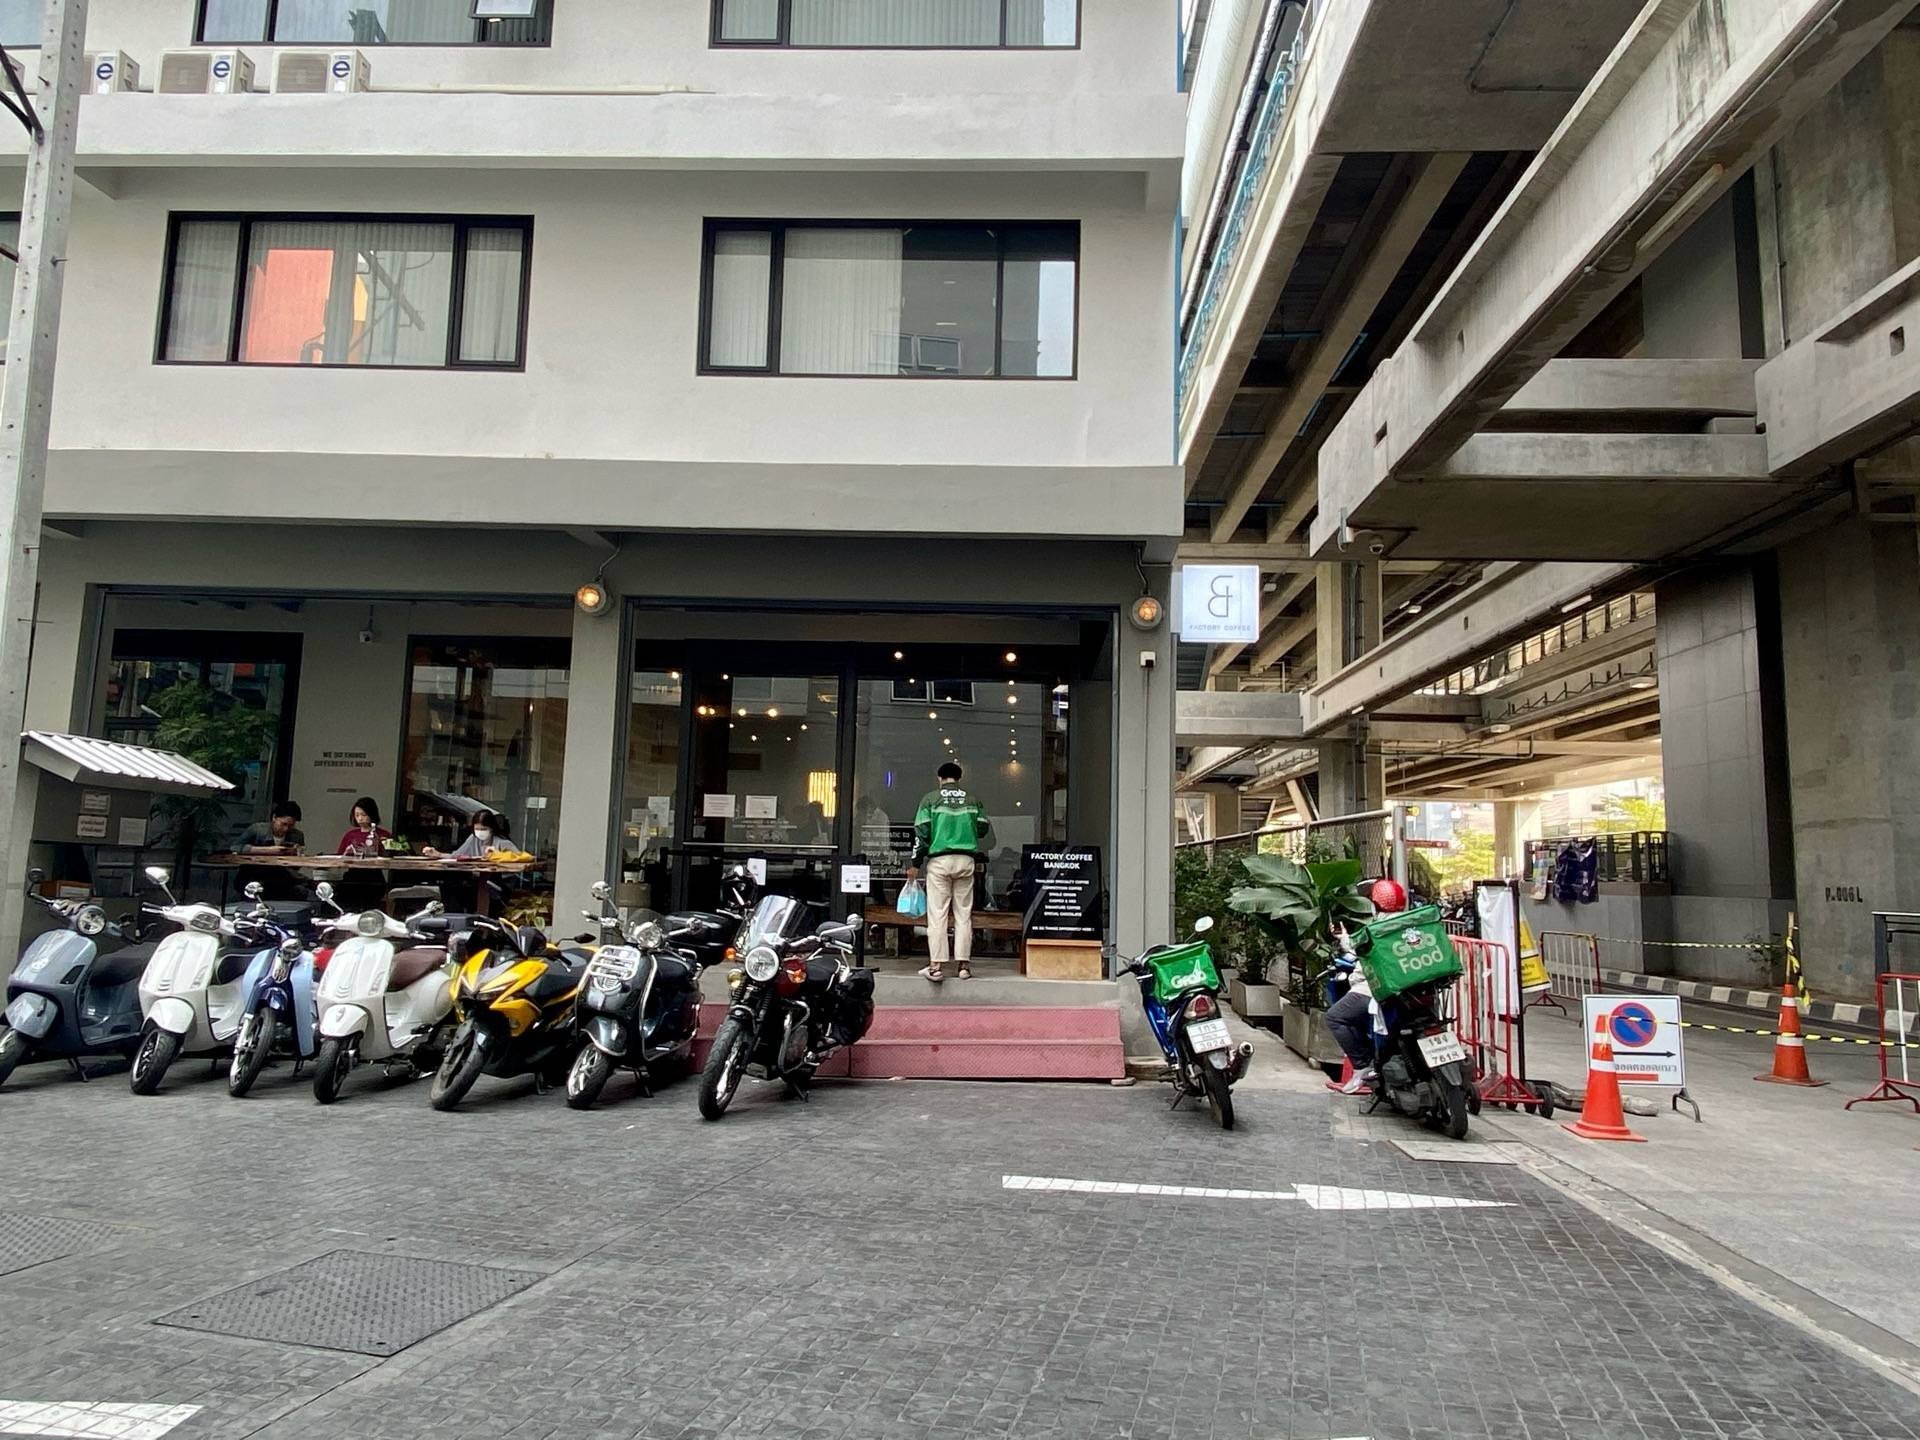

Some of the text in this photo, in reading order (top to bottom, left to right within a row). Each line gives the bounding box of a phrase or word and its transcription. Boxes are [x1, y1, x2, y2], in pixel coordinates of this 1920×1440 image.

[940, 789, 967, 797] Grab
[1065, 853, 1093, 861] COFFEE
[1044, 861, 1080, 869] BANGKOK
[1398, 945, 1444, 975] Food
